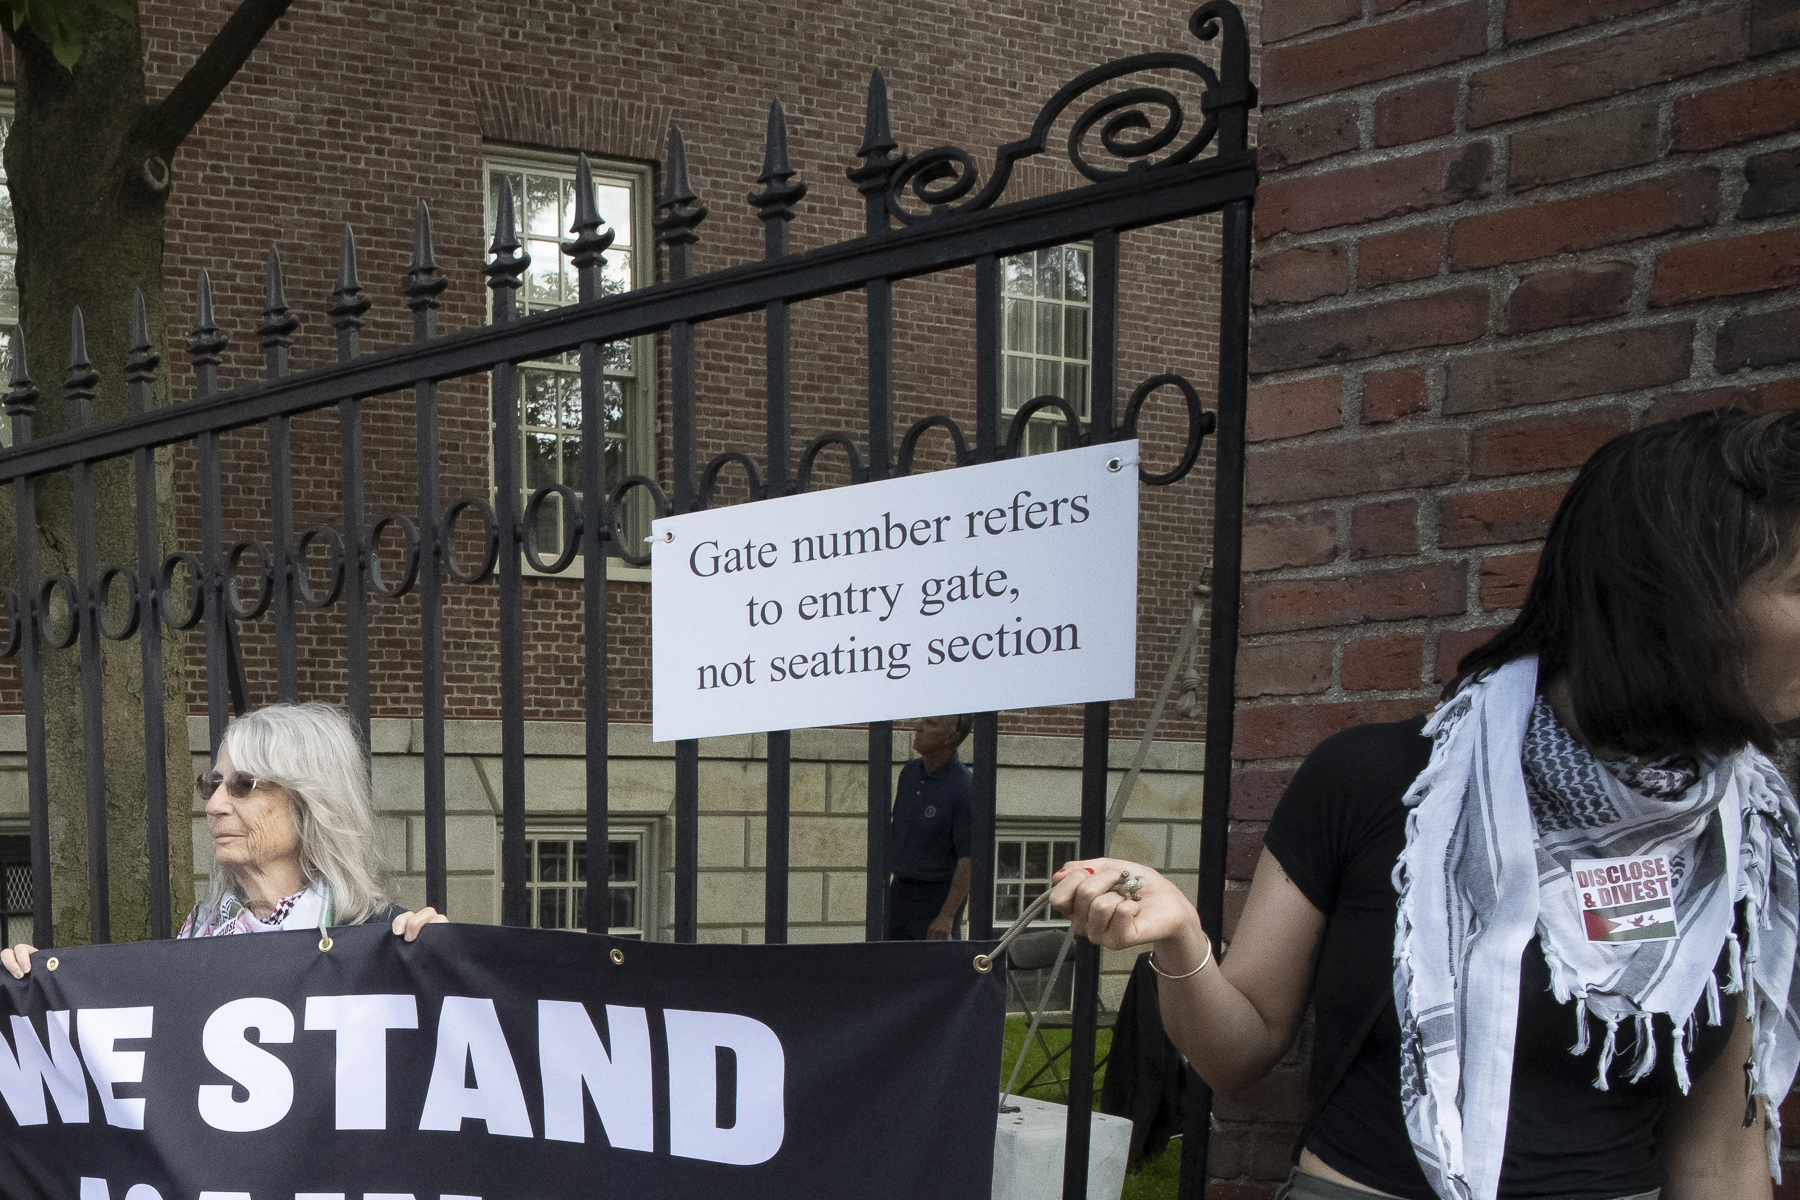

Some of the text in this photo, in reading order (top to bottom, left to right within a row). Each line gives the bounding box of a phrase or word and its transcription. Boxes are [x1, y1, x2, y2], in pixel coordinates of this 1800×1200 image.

[689, 490, 1090, 578] Gate number refers
[746, 566, 1020, 627] to entry gate,
[696, 615, 1082, 690] not seating section
[1575, 857, 1667, 888] DISCLOSE
[1582, 876, 1669, 908] & DIVEST
[197, 994, 787, 1166] STAND
